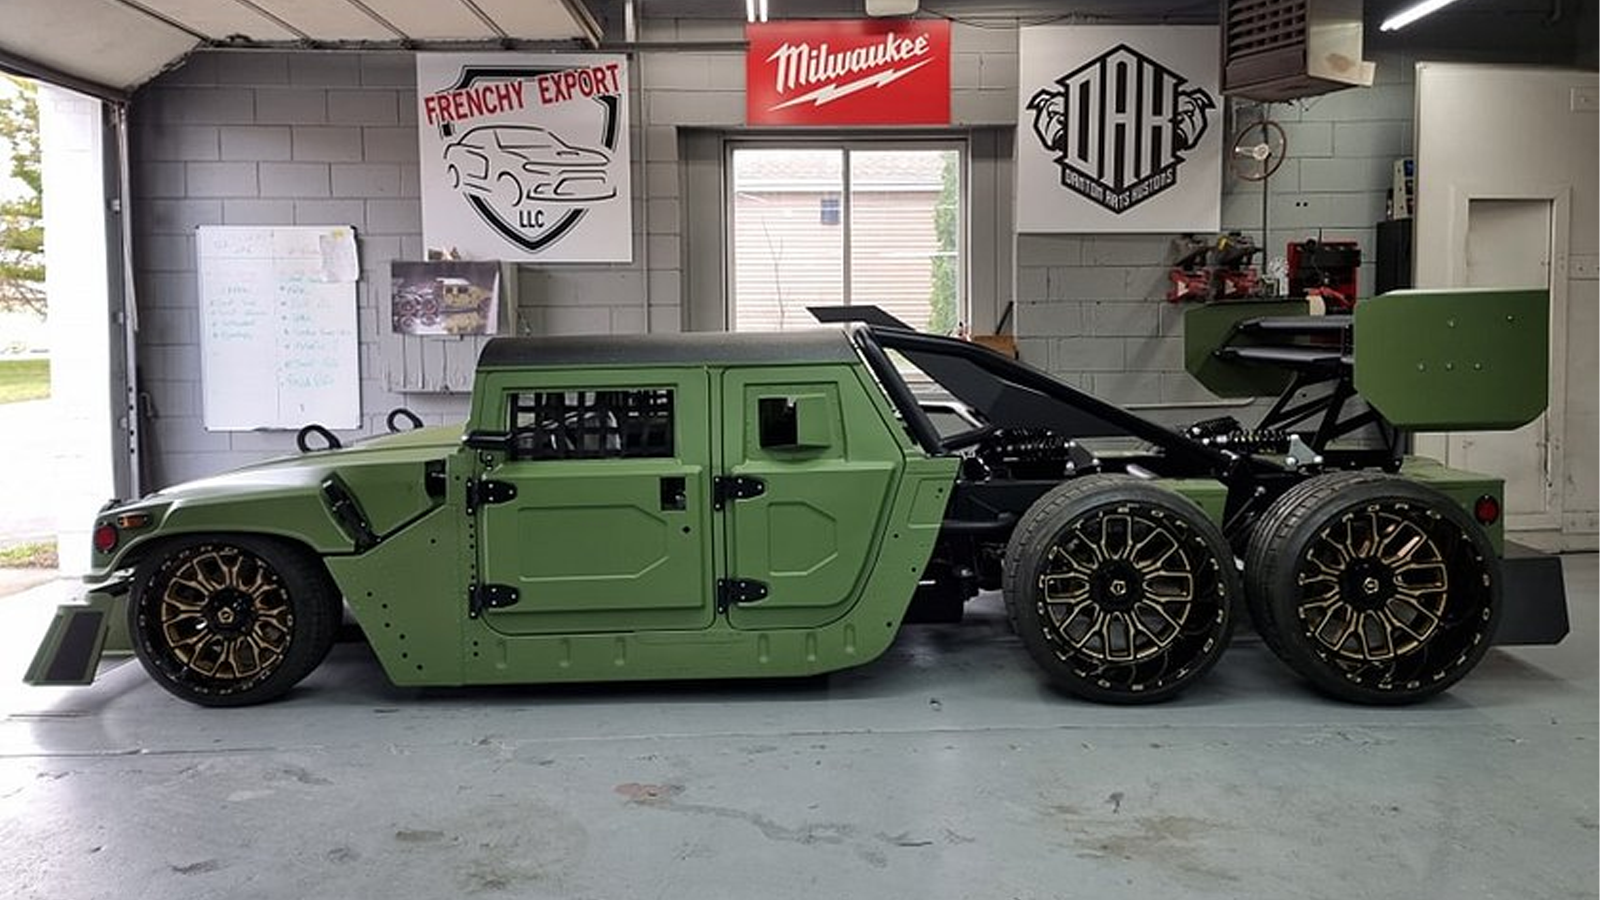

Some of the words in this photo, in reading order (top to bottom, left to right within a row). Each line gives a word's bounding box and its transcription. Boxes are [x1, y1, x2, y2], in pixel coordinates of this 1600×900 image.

[765, 32, 930, 94] Milwaukee
[424, 80, 524, 124] FRENCHY
[538, 64, 619, 104] EXPORT
[519, 210, 545, 228] LLC
